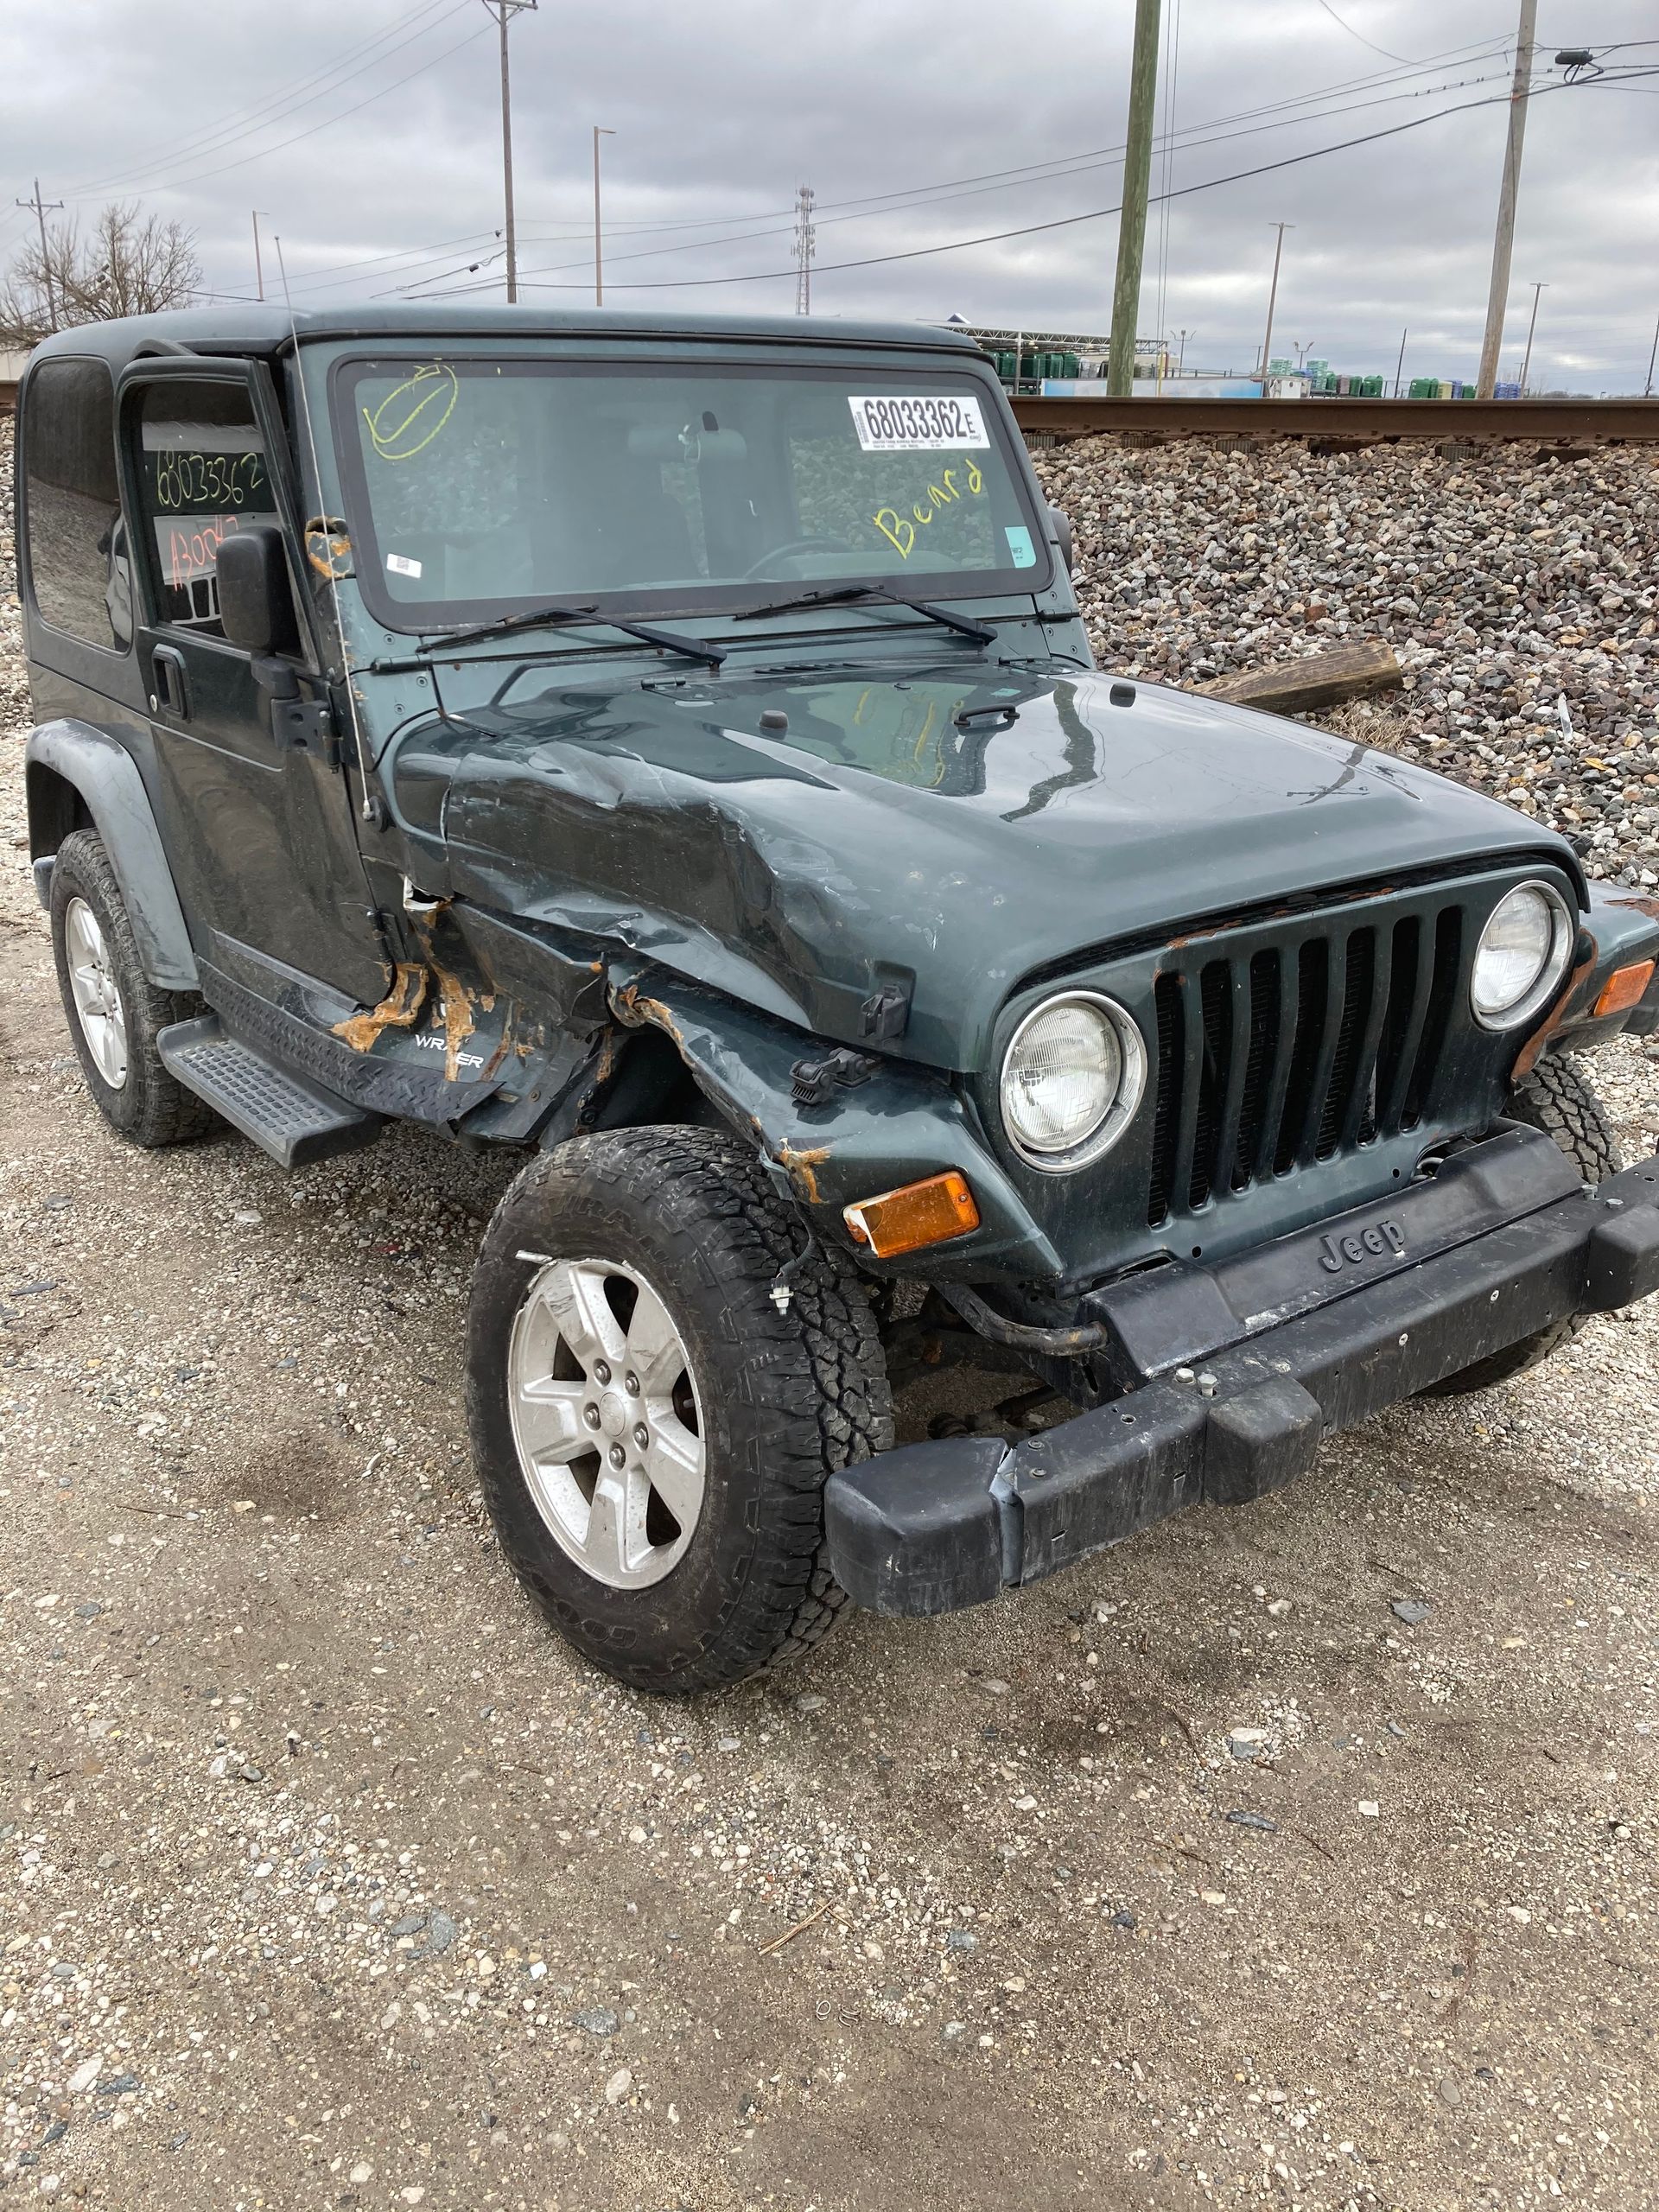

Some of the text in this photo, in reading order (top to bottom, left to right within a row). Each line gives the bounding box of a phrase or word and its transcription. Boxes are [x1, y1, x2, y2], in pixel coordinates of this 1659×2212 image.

[864, 399, 967, 439] 68033362
[964, 413, 976, 434] E
[1318, 1220, 1405, 1274] Jeep
